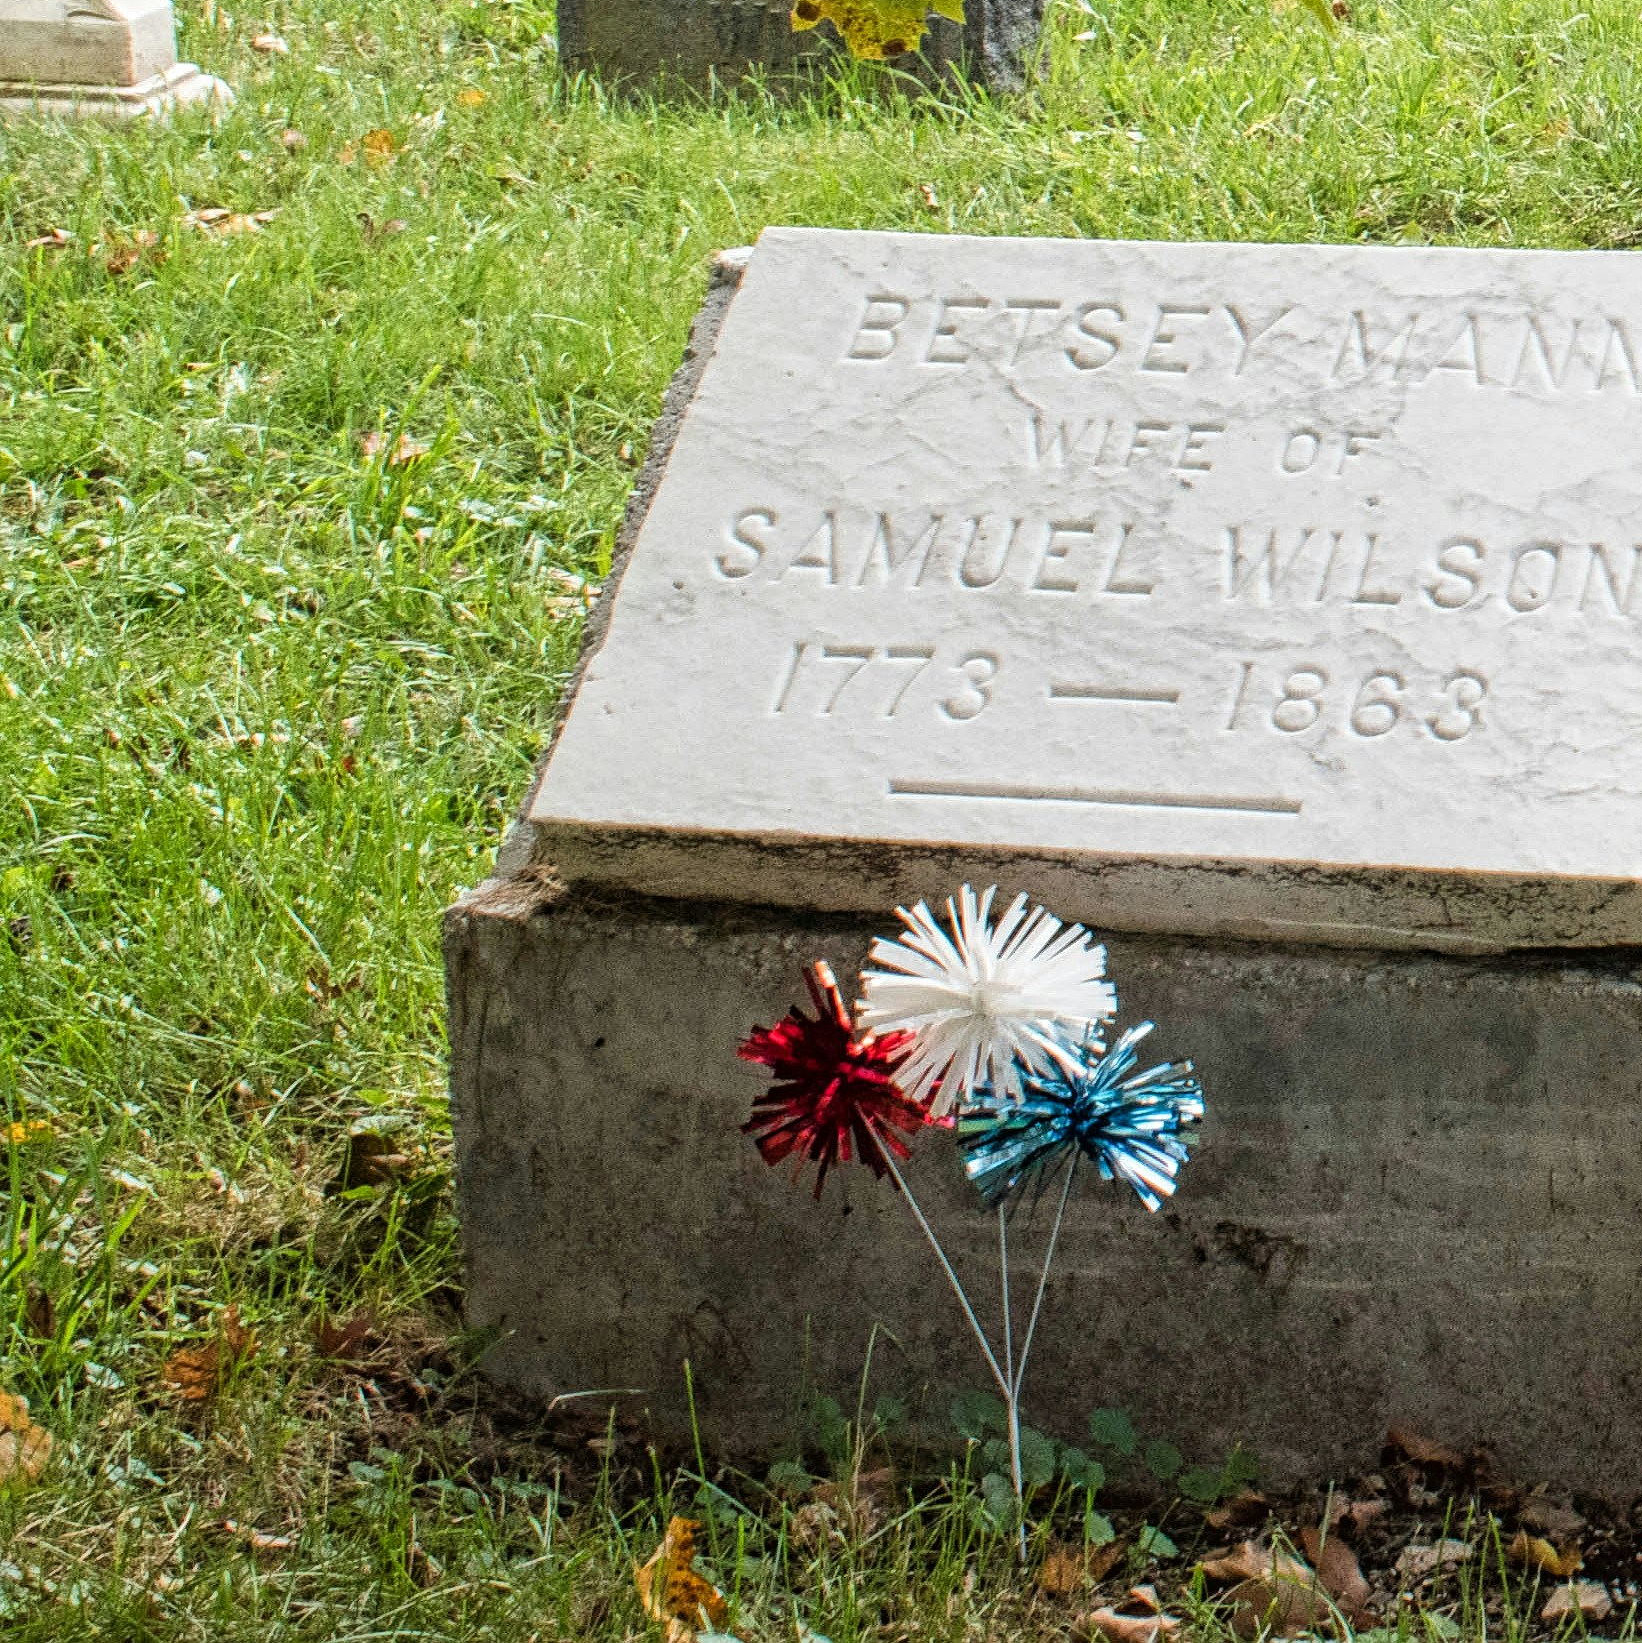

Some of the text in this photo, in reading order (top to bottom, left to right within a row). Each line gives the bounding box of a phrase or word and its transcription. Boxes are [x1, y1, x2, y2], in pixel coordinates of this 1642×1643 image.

[846, 292, 1299, 372] BETSEY
[1027, 410, 1383, 475] WIFE OF
[713, 505, 1158, 595] SAMUEL
[771, 639, 1001, 721] 1773
[1225, 661, 1491, 743] 1863
